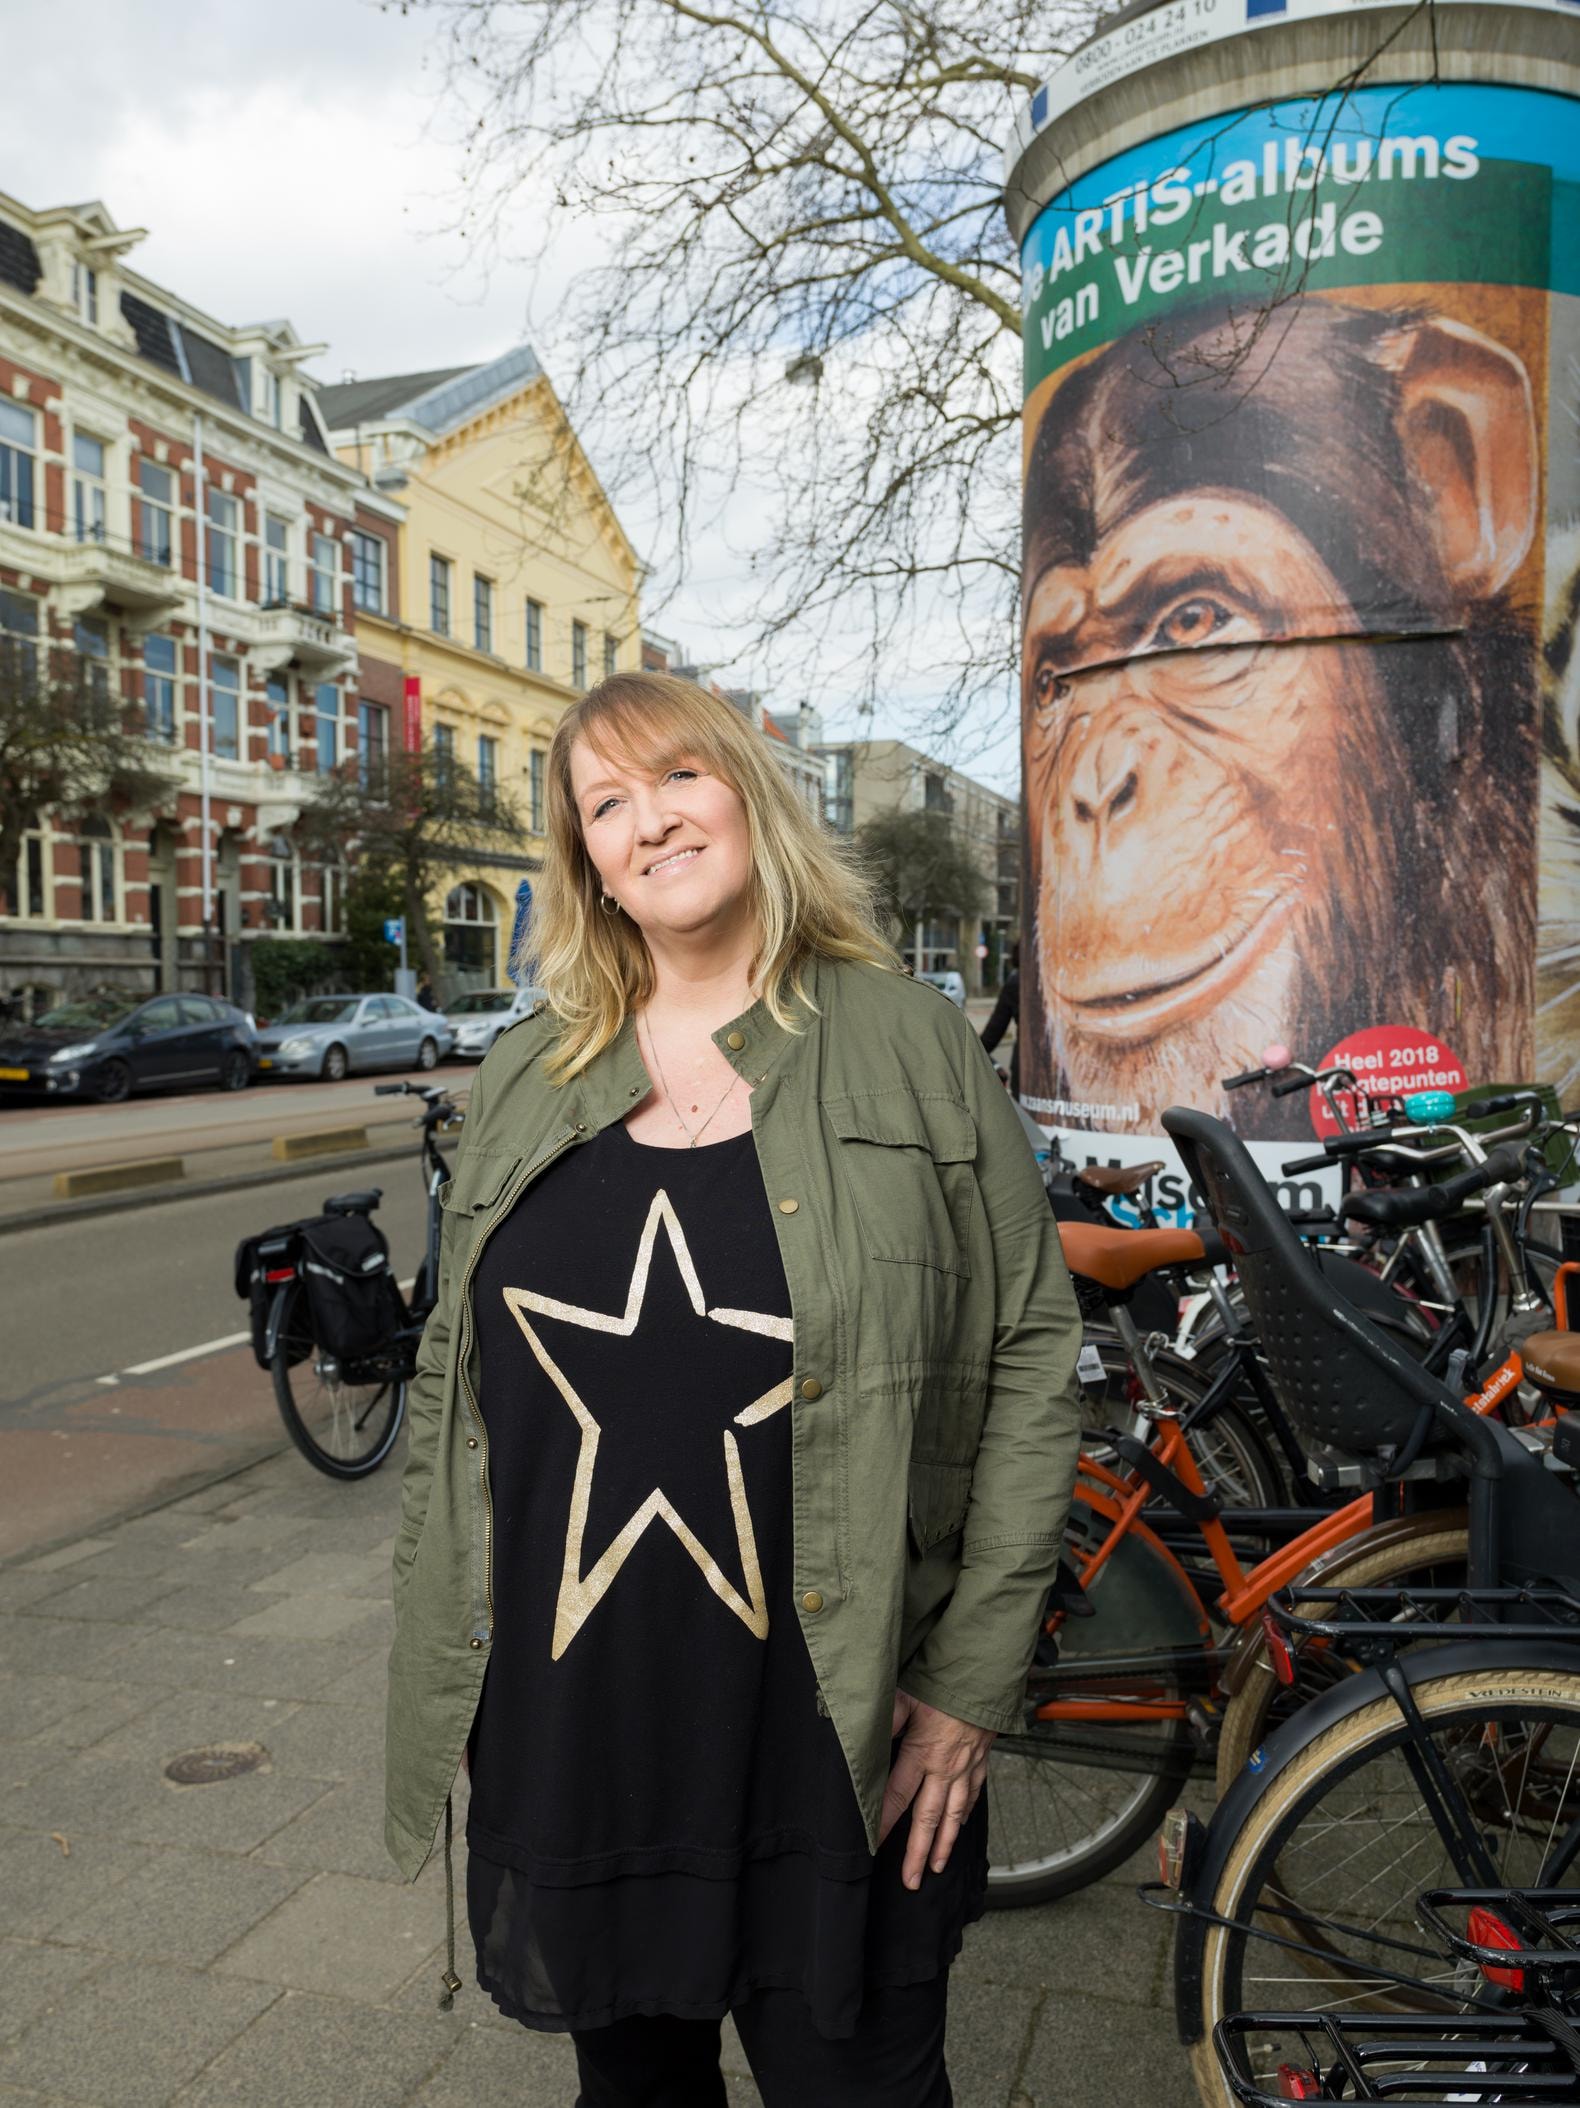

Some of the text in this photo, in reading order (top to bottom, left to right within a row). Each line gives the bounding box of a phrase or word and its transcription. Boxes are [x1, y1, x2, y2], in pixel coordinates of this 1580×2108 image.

[1124, 19, 1156, 45] 024
[1164, 6, 1185, 28] 24
[1049, 134, 1480, 284] ARTIS-albums
[1040, 202, 1384, 350] van Verkade
[1334, 1046, 1439, 1071] Heel 2018
[1316, 1069, 1461, 1097] gtepunten
